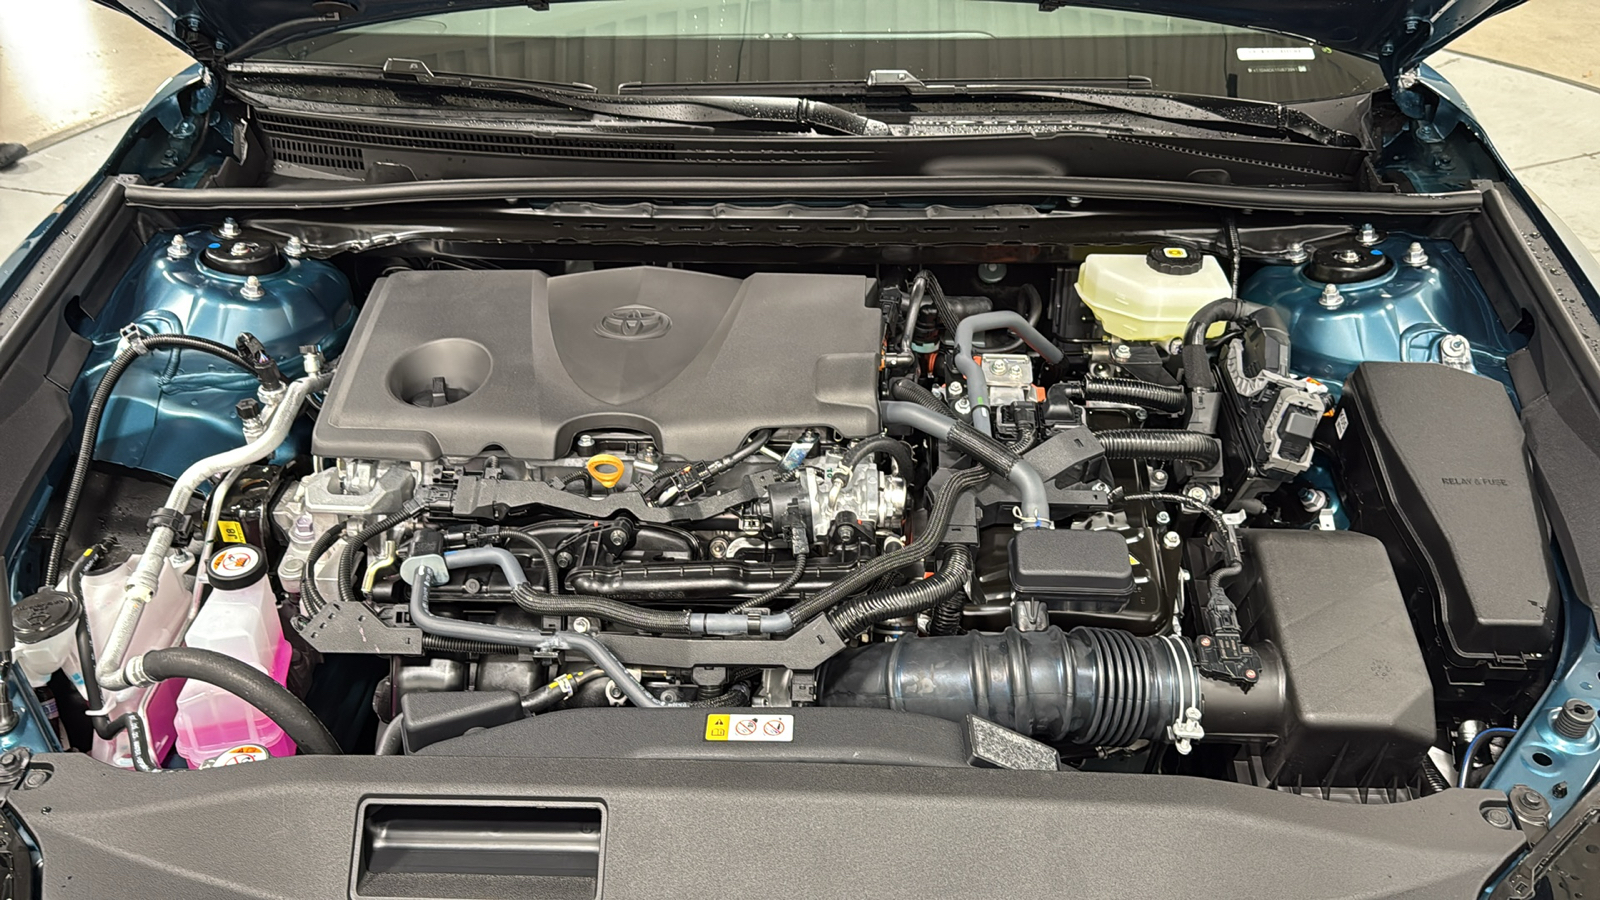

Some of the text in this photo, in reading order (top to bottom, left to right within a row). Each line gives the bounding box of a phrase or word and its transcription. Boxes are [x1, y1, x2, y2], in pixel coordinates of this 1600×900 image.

[1441, 477, 1472, 486] RELAY
[1482, 478, 1509, 487] FUSE
[226, 528, 238, 539] J8
